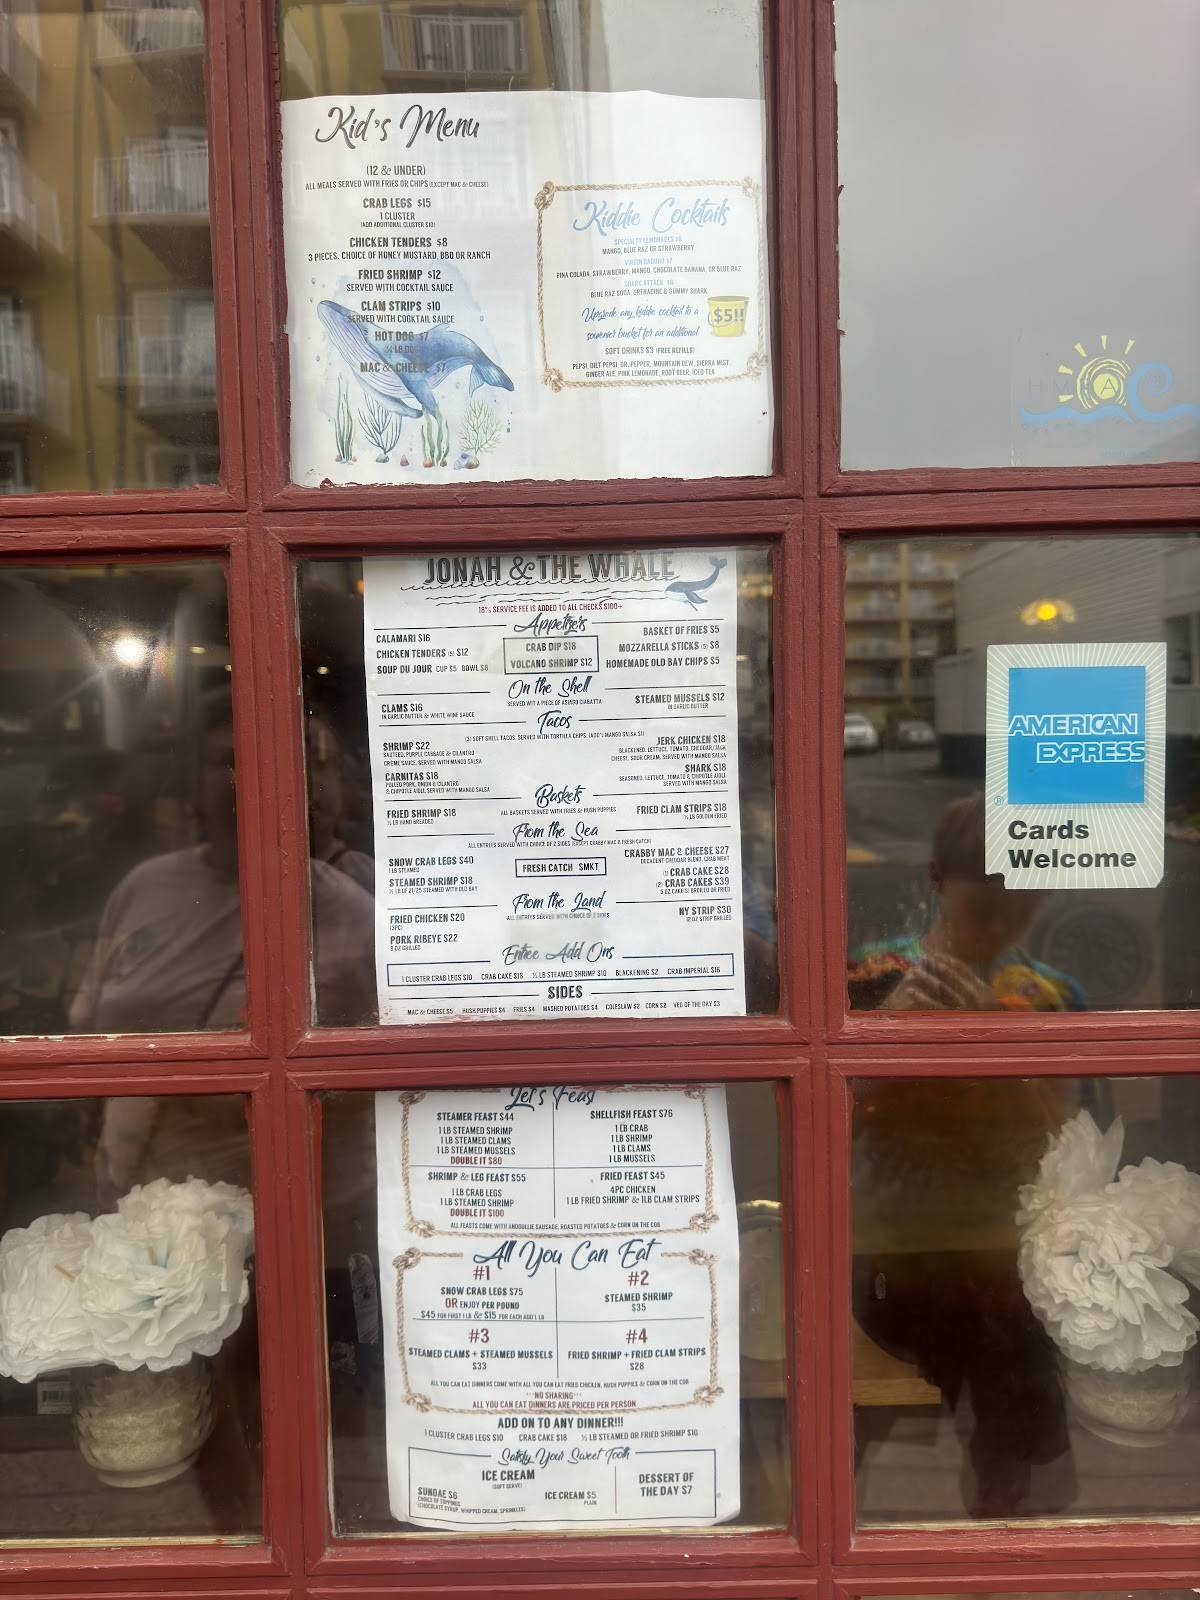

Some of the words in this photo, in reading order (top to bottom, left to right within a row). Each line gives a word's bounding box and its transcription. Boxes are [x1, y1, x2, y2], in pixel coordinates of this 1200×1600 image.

[315, 105, 391, 149] Kid's
[400, 104, 480, 149] Menu
[366, 165, 378, 175] (12
[381, 167, 392, 175] &
[394, 165, 426, 175] UNDER)
[363, 198, 388, 208] CRAB
[390, 198, 412, 208] LEGS
[417, 198, 431, 208] $15
[385, 212, 415, 220] CLUSTER
[573, 200, 640, 236] Kiddie
[652, 197, 731, 233] Cocktails
[349, 237, 388, 248] CHICKEN
[391, 237, 432, 248] TENDERS
[437, 237, 448, 247] $8
[308, 254, 313, 262] 3
[314, 252, 339, 261] PIECES.
[341, 251, 365, 260] CHOICE
[368, 251, 376, 259] OF
[378, 251, 401, 259] HONEY
[403, 251, 439, 260] MUSTARD,
[440, 251, 454, 260] BBQ
[456, 251, 465, 259] OR
[467, 251, 491, 259] RANCH
[358, 270, 384, 280] FRIED
[387, 270, 423, 280] SHRIMP
[427, 270, 441, 279] $12
[346, 284, 375, 292] SERVED
[376, 284, 395, 292] WITH
[396, 284, 430, 292] COCKTAIL
[432, 284, 453, 292] SAUCE
[361, 301, 386, 312] CLAM
[388, 301, 422, 311] STRIPS
[427, 301, 441, 311] $10
[605, 347, 620, 355] SOFT
[423, 557, 501, 584] JONAH
[509, 556, 535, 579] &
[537, 554, 582, 580] THE
[588, 552, 674, 579] WHALE
[643, 627, 673, 636] BASKET
[675, 627, 684, 635] OF
[686, 626, 708, 634] FRIES
[710, 626, 720, 634] $5
[376, 634, 416, 643] CALAMARI
[619, 643, 669, 652] MOZZARELLA
[671, 642, 699, 650] STICKS
[710, 641, 720, 649] $8
[376, 650, 410, 659] CHICKEN
[412, 649, 446, 658] TENDERS
[456, 648, 468, 657] $12
[511, 659, 547, 669] VOLCANO
[548, 658, 579, 667] SHRIMP
[580, 658, 592, 667] $12
[606, 659, 649, 668] HOMEMADE
[651, 658, 666, 667] OLD
[668, 658, 683, 666] BAY
[685, 657, 708, 666] CHIPS
[710, 657, 720, 665] $5
[377, 666, 398, 674] SOUP
[400, 666, 410, 674] DU
[412, 665, 432, 673] JOUR
[508, 679, 530, 699] On
[534, 677, 552, 694] the
[558, 676, 592, 698] Shell
[635, 695, 672, 704] STEAMED
[674, 694, 710, 702] MUSSELS
[712, 693, 724, 701] $12
[382, 704, 408, 712] CLAMS
[538, 710, 572, 734] Tacos
[1008, 714, 1138, 736] AMERICAN
[656, 736, 676, 745] JERK
[678, 736, 711, 744] CHICKEN
[713, 735, 726, 743] $18
[383, 742, 413, 751] SHRIMP
[415, 742, 430, 750] $22
[1037, 742, 1145, 763] EXPRESS
[685, 764, 711, 772] SHARK
[713, 763, 727, 772] $18
[385, 772, 424, 781] CARNITAS
[426, 772, 438, 780] $18
[535, 783, 586, 808] Baskets
[637, 806, 659, 815] FRIED
[661, 805, 682, 814] CLAM
[684, 804, 712, 813] STRIPS
[714, 803, 727, 812] $18
[512, 822, 544, 842] From
[549, 821, 565, 838] the
[571, 821, 599, 841] Sea
[1008, 819, 1089, 840] Cards
[388, 858, 413, 867] SNOW
[415, 857, 436, 866] CRAB
[438, 856, 457, 865] LEGS
[459, 856, 474, 864] $40
[1008, 849, 1137, 868] Welcome
[522, 864, 547, 872] FRESH
[548, 863, 574, 872] CATCH
[390, 915, 413, 924] FRIED
[415, 914, 448, 923] CHICKEN
[450, 913, 465, 922] $20
[390, 936, 412, 944] PORK
[414, 935, 442, 944] RIBEYE
[443, 934, 458, 942] $22
[548, 985, 584, 999] SIDES
[437, 1112, 472, 1121] STEAMER
[474, 1113, 497, 1121] FEAST
[500, 1113, 514, 1121] $44
[590, 1110, 632, 1119] SHELLFISH
[633, 1110, 656, 1118] FEAST
[659, 1109, 673, 1117] $76
[443, 1126, 451, 1134] LB
[473, 1240, 517, 1269] All
[519, 1240, 562, 1278] You
[571, 1241, 609, 1270] Can
[618, 1238, 662, 1269] Eat
[473, 1265, 490, 1281] #1
[628, 1270, 649, 1287] #2
[441, 1287, 464, 1295] SNOW
[466, 1287, 487, 1295] CRAB
[489, 1287, 507, 1296] LEGS
[509, 1288, 523, 1296] $75
[605, 1293, 640, 1302] STEAMED
[642, 1292, 673, 1301] SHRIMP
[468, 1328, 490, 1343] #3
[626, 1328, 648, 1344] #4
[472, 1362, 486, 1370] $33
[630, 1362, 644, 1370] $28
[497, 1417, 518, 1428] ADD
[521, 1417, 535, 1428] ON
[538, 1417, 551, 1428] TO
[553, 1417, 574, 1428] ANY
[577, 1416, 624, 1428] DINNER!!!
[482, 1470, 497, 1481] ICE
[500, 1470, 535, 1481] CREAM
[639, 1473, 680, 1483] DESSERT
[683, 1472, 694, 1482] OF
[418, 1487, 446, 1498] SUNDAE
[640, 1487, 658, 1496] THE
[660, 1486, 679, 1495] DAY
[682, 1485, 692, 1495] $7
